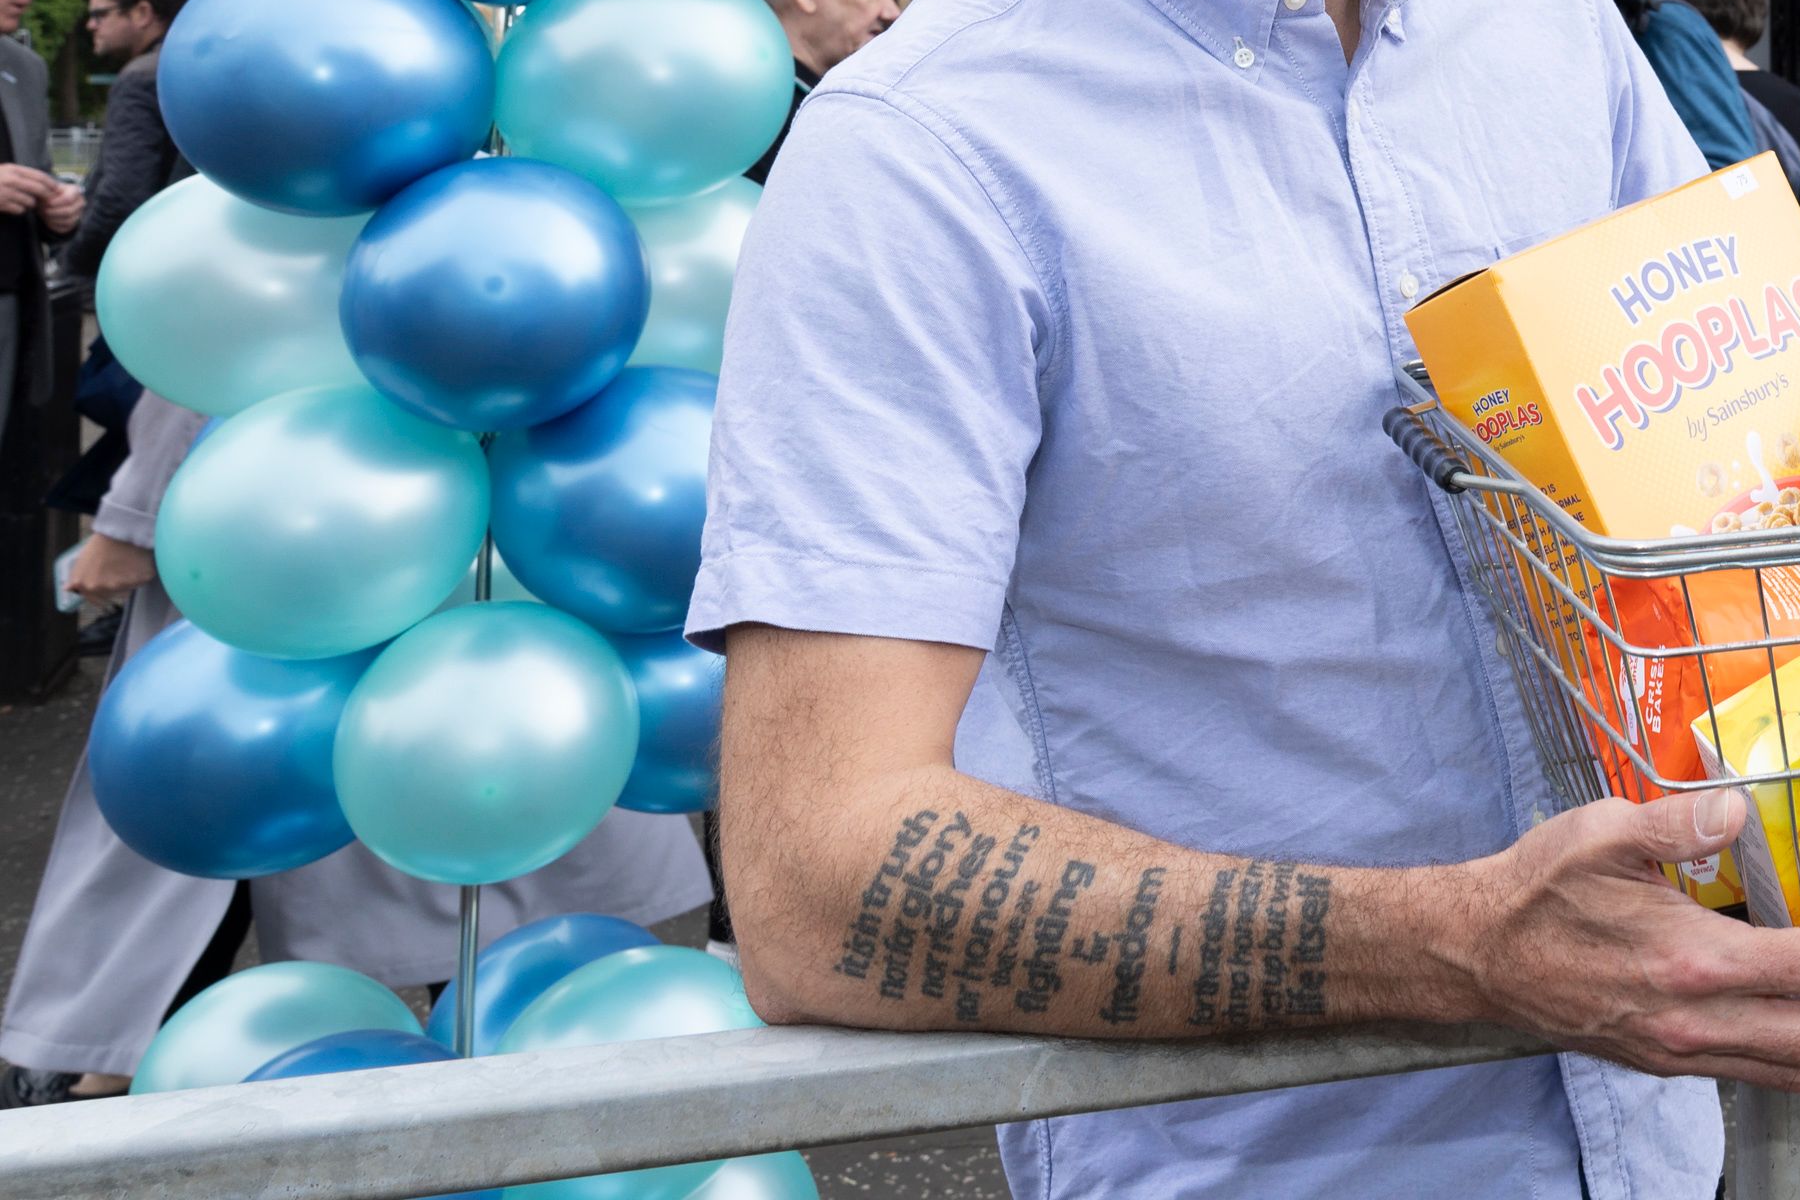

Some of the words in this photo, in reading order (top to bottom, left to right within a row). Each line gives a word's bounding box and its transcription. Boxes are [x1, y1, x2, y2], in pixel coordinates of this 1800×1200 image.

[1610, 236, 1741, 326] HONEY
[1472, 389, 1510, 417] HONEY
[1473, 402, 1543, 444] OOPLAS
[1687, 413, 1709, 441] by
[1707, 372, 1790, 427] Sainsbury's
[863, 810, 940, 909] truth
[902, 811, 972, 921] glory
[925, 833, 996, 953] riches
[1690, 865, 1715, 877] SERVINGS
[952, 823, 1041, 982] honours
[1014, 880, 1042, 916] are
[1200, 868, 1238, 941] alone
[1227, 878, 1264, 967] honest
[1290, 873, 1332, 964] itself
[883, 918, 917, 956] for
[1014, 859, 1097, 1013] fighting
[1100, 866, 1168, 1025] freedom
[880, 952, 912, 1000] not
[921, 952, 949, 999] nor
[955, 982, 981, 1023] nor
[1285, 970, 1328, 1016] life
